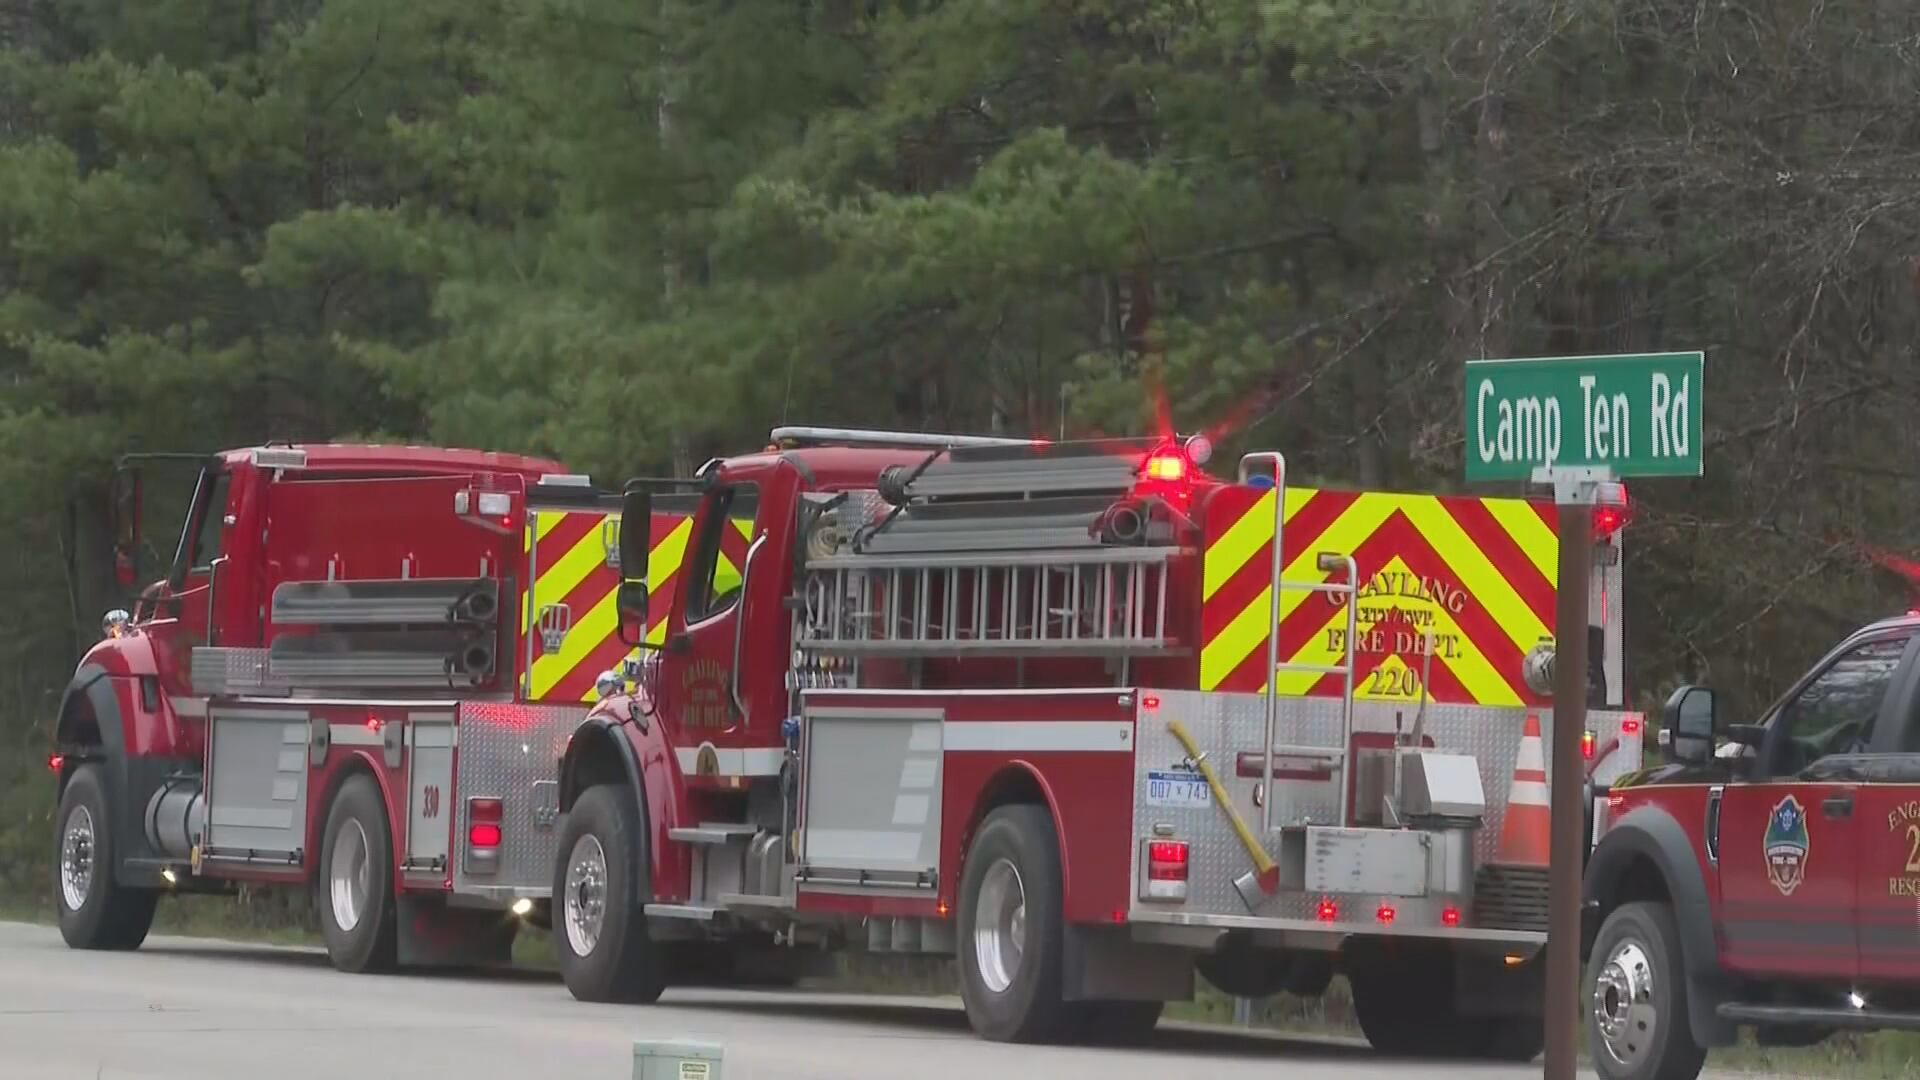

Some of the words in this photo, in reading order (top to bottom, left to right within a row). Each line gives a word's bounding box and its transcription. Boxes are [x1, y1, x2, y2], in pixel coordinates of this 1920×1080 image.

[1477, 378, 1561, 470] Camp
[1579, 375, 1630, 460] Ten
[1651, 371, 1690, 458] Rd
[1325, 571, 1468, 614] GAYLING
[1327, 628, 1385, 653] FRE
[1367, 666, 1420, 697] 220
[1150, 781, 1172, 798] 007
[1888, 800, 1920, 832] ENG
